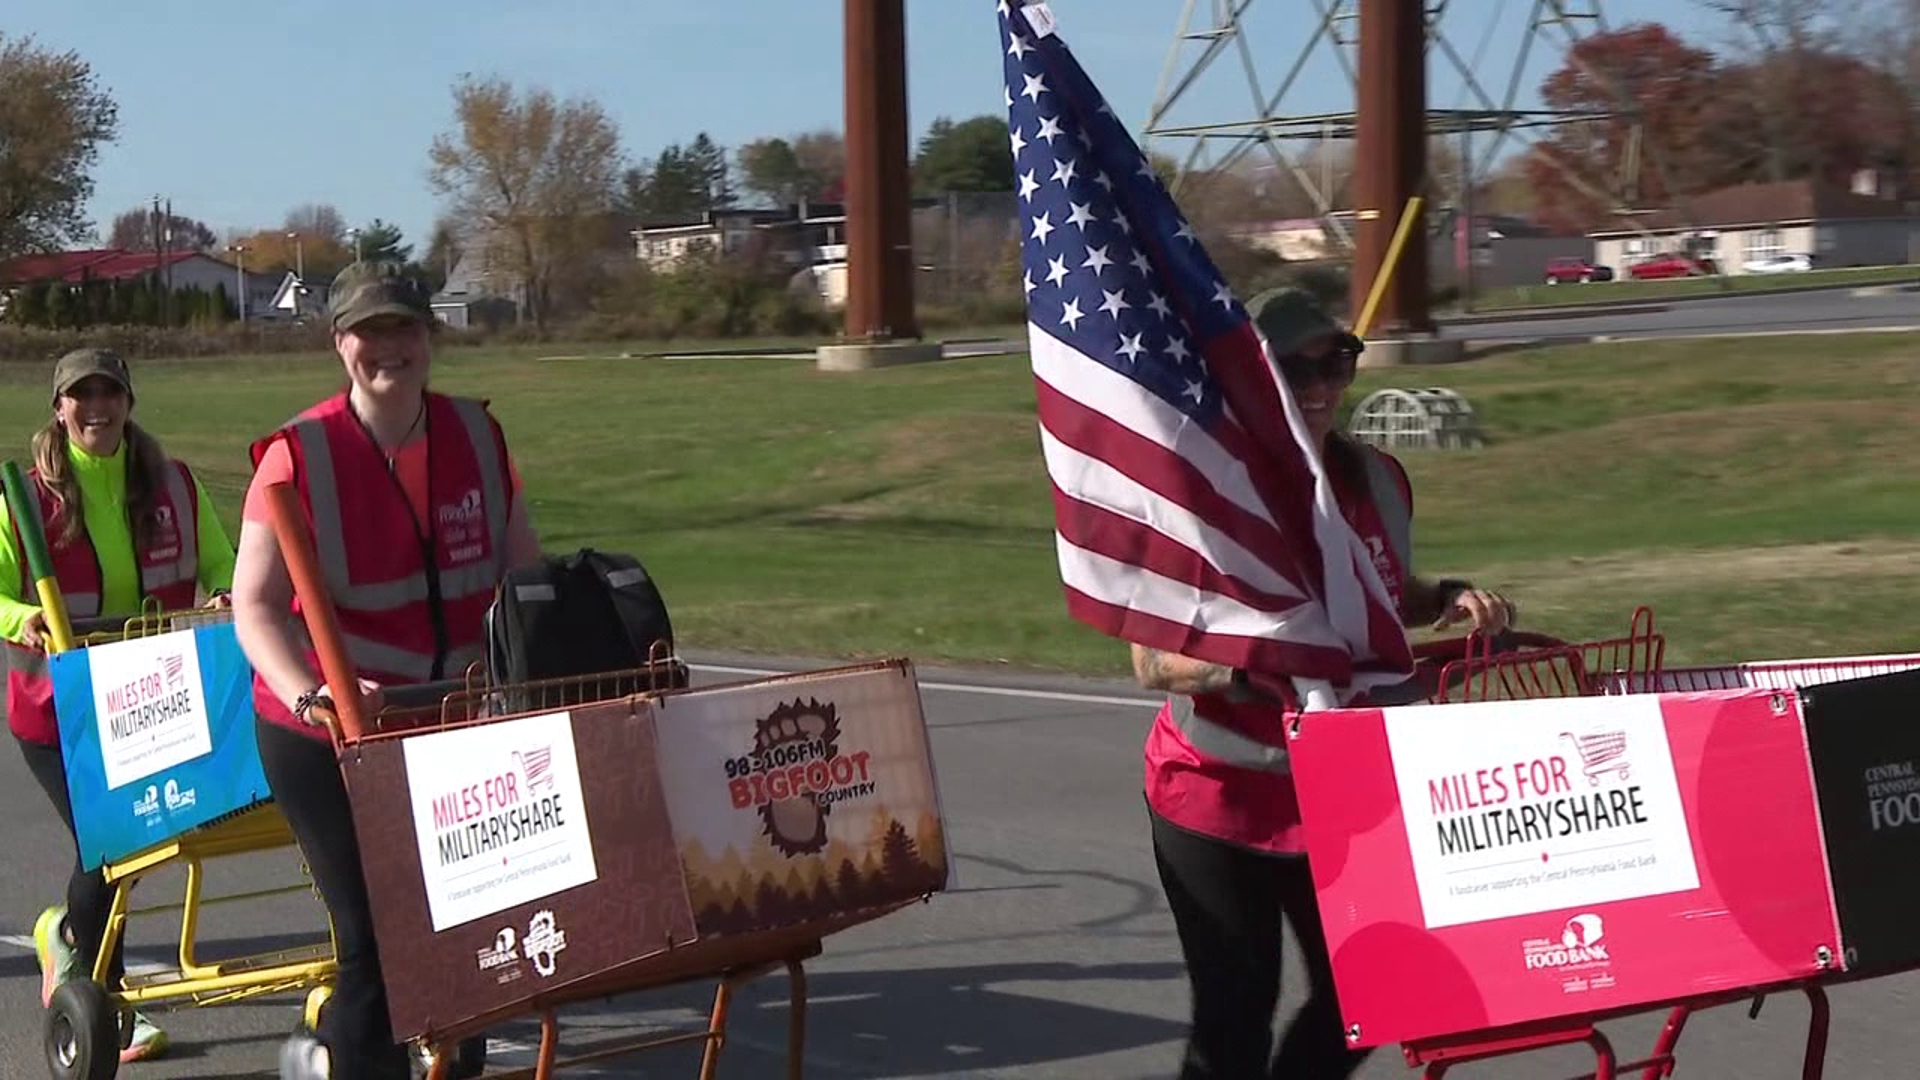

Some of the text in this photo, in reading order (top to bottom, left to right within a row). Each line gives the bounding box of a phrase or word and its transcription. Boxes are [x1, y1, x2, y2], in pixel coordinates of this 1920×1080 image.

[106, 672, 162, 714] MILES FOR
[110, 689, 192, 741] MILITARYSHARE
[728, 751, 871, 810] BIGFOOT
[817, 782, 875, 805] COUNTRY
[1428, 755, 1572, 815] MILES FOR
[1865, 761, 1914, 781] CENTRAL
[432, 771, 519, 831] MILES FOR
[1436, 785, 1649, 857] MILITARYSHARE
[438, 794, 565, 867] MILITARYSHARE
[1525, 949, 1568, 970] FOOD
[1568, 944, 1610, 964] BANK
